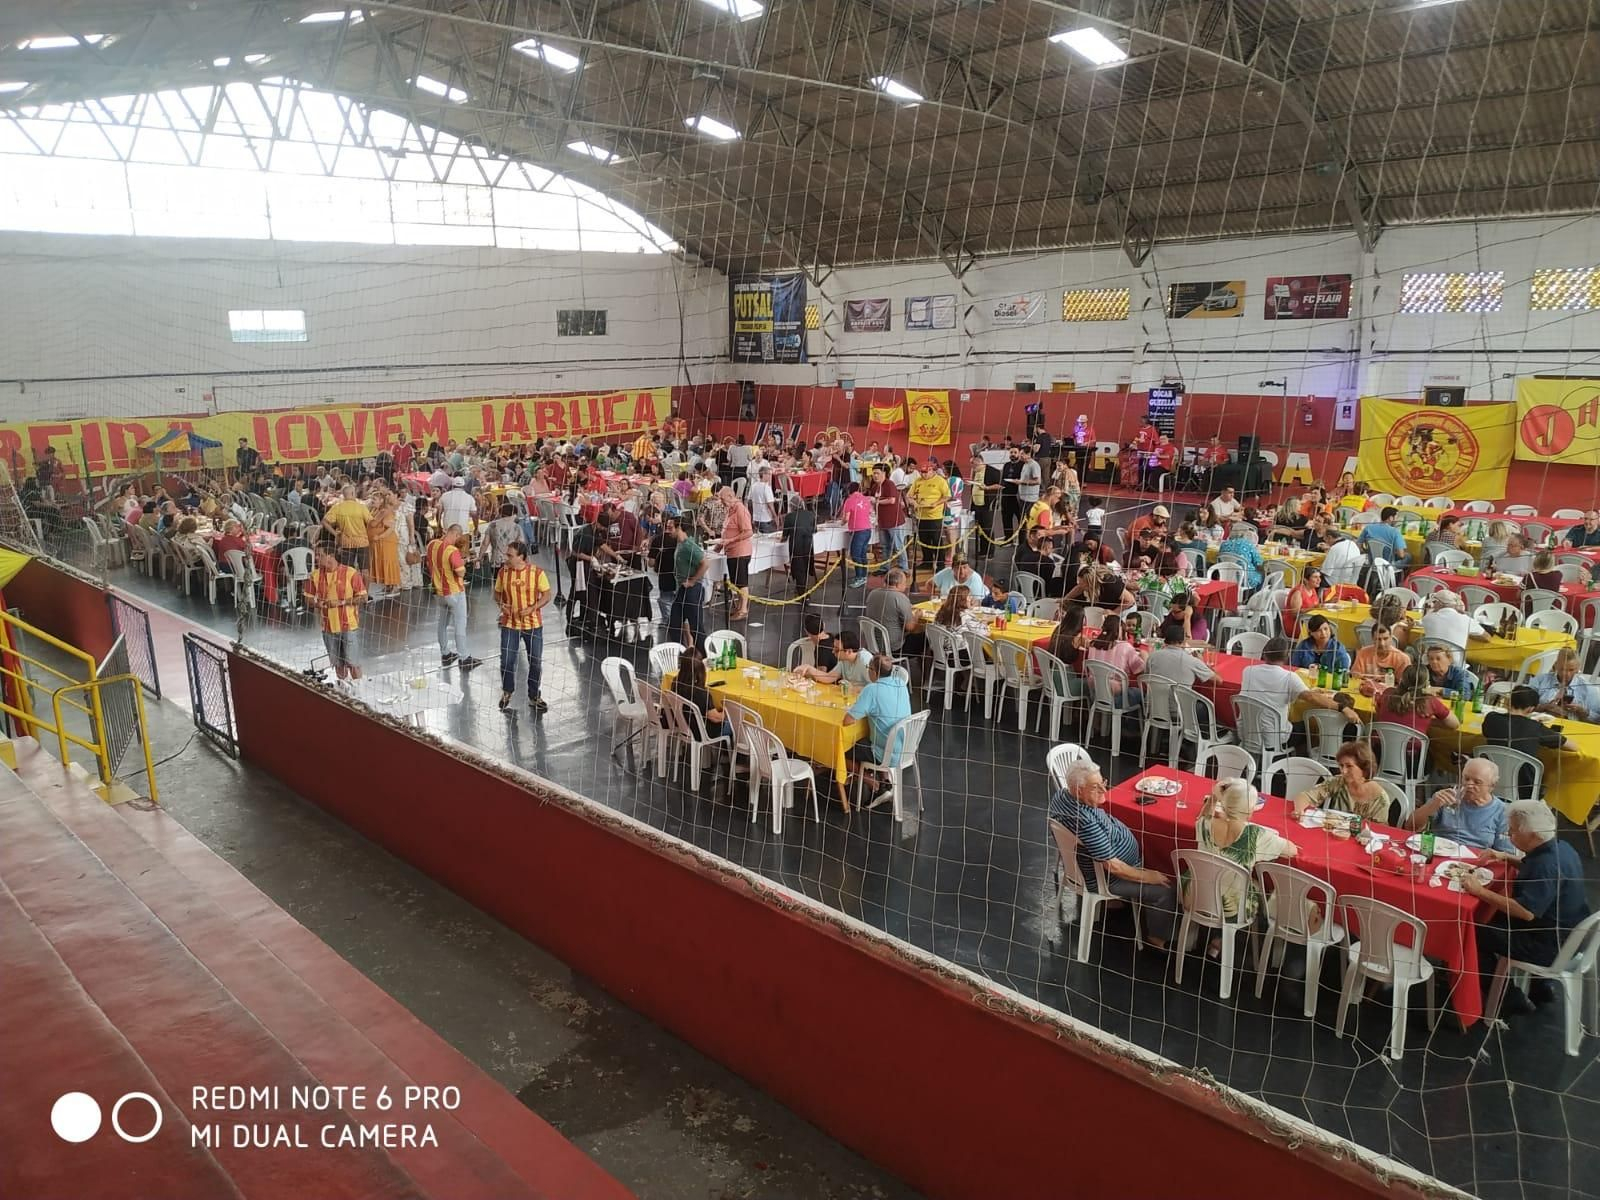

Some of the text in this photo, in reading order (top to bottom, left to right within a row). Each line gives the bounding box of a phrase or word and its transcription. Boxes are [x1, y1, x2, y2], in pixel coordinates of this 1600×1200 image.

[734, 292, 774, 318] FUTSAL
[1303, 294, 1342, 303] FC FLAIR
[1152, 390, 1173, 398] OSCAR
[476, 392, 658, 443] JABUCA
